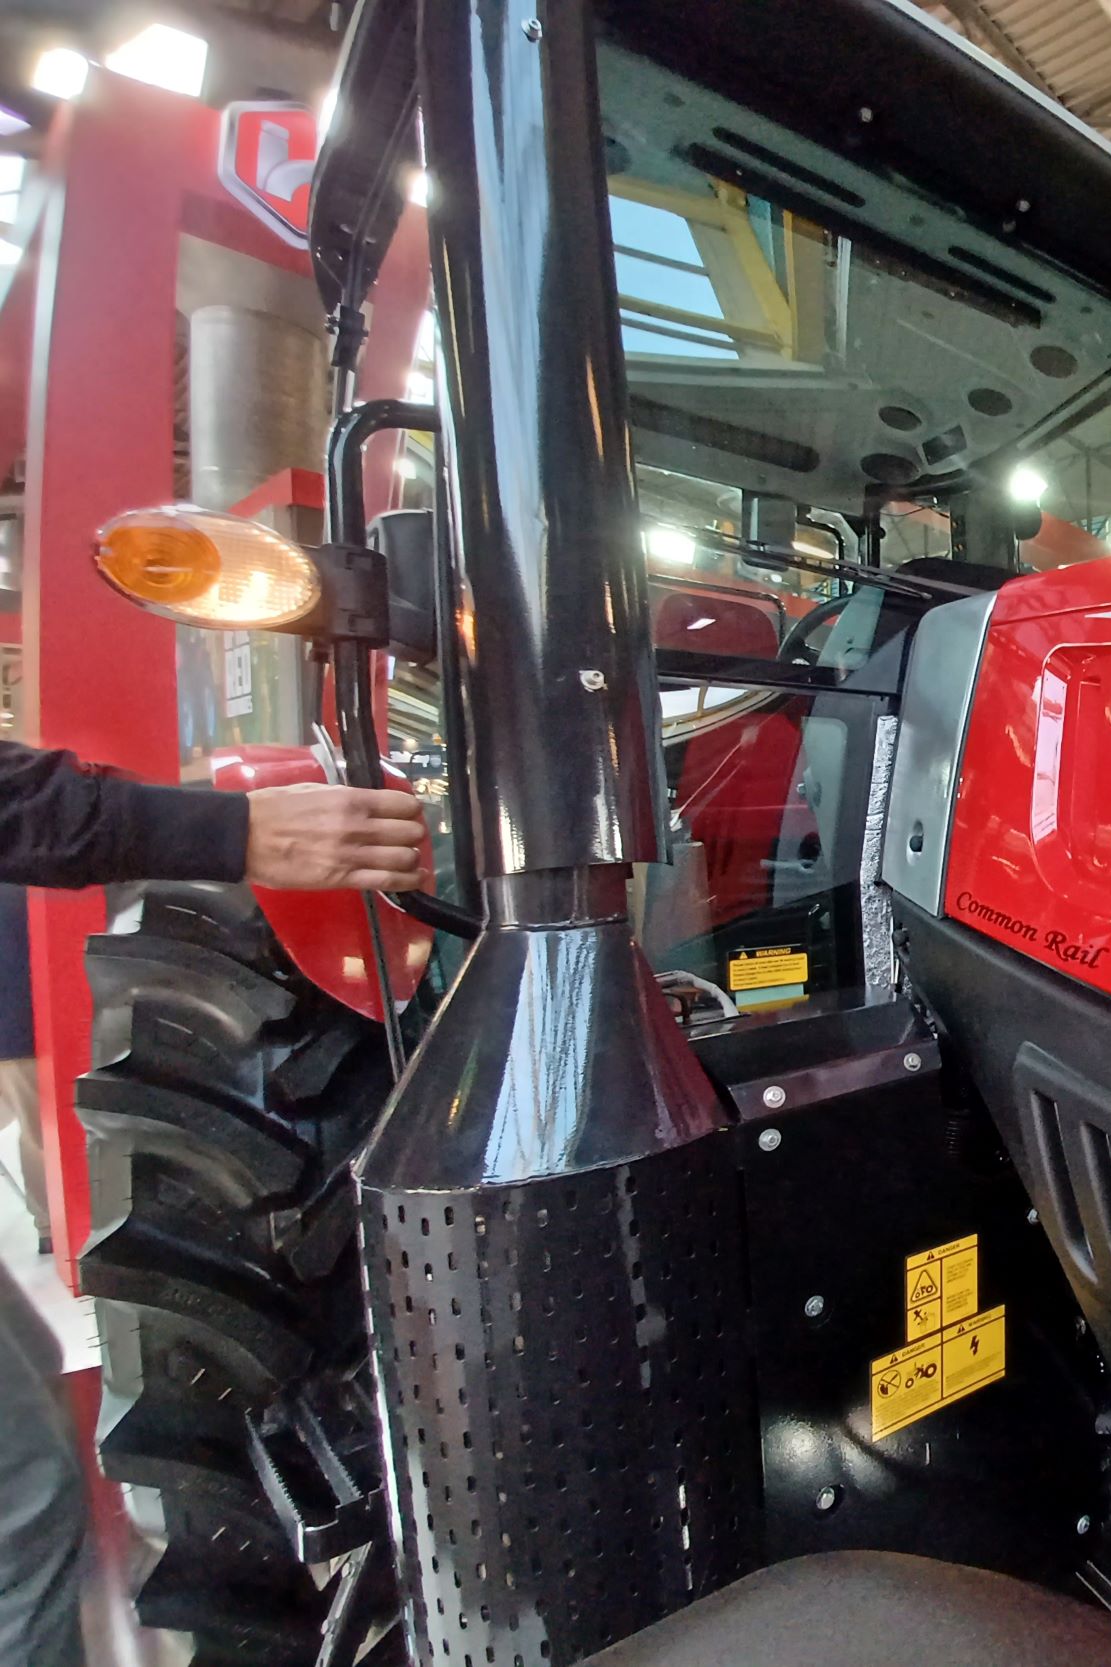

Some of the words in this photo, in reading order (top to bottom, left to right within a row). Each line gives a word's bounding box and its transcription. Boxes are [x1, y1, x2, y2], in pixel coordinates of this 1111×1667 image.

[955, 891, 1038, 941] Common
[1044, 930, 1110, 969] Rail
[756, 947, 792, 957] WARNING
[937, 1243, 960, 1255] DANGER
[901, 1343, 926, 1357] DANGER
